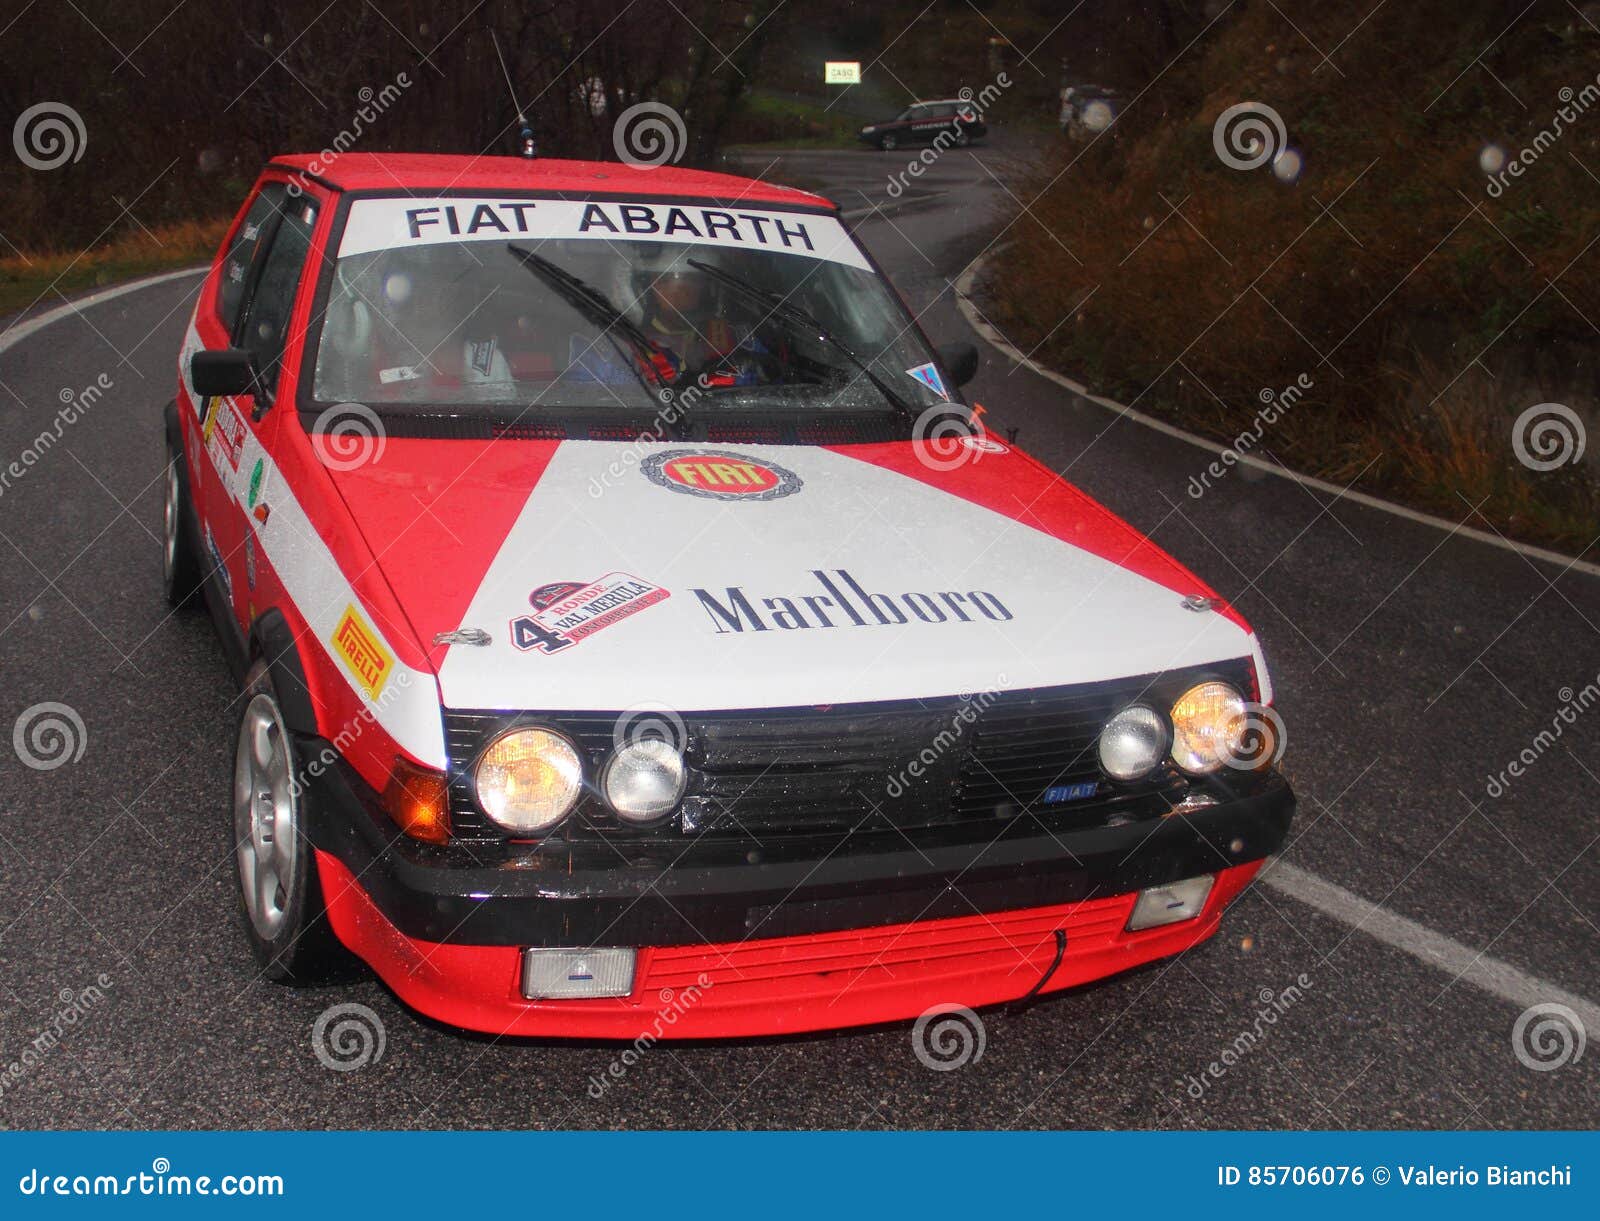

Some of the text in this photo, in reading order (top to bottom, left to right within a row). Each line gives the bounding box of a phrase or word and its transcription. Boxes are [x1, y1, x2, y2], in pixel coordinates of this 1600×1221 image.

[406, 203, 816, 251] FIAT ABARTH
[671, 463, 767, 486] FIAT
[552, 584, 609, 616] RONDE
[555, 612, 590, 629] VAL
[582, 581, 653, 616] MERULA
[687, 569, 1014, 633] Marlboro
[337, 615, 385, 688] PIRELLI
[1046, 784, 1097, 801] FIAT
